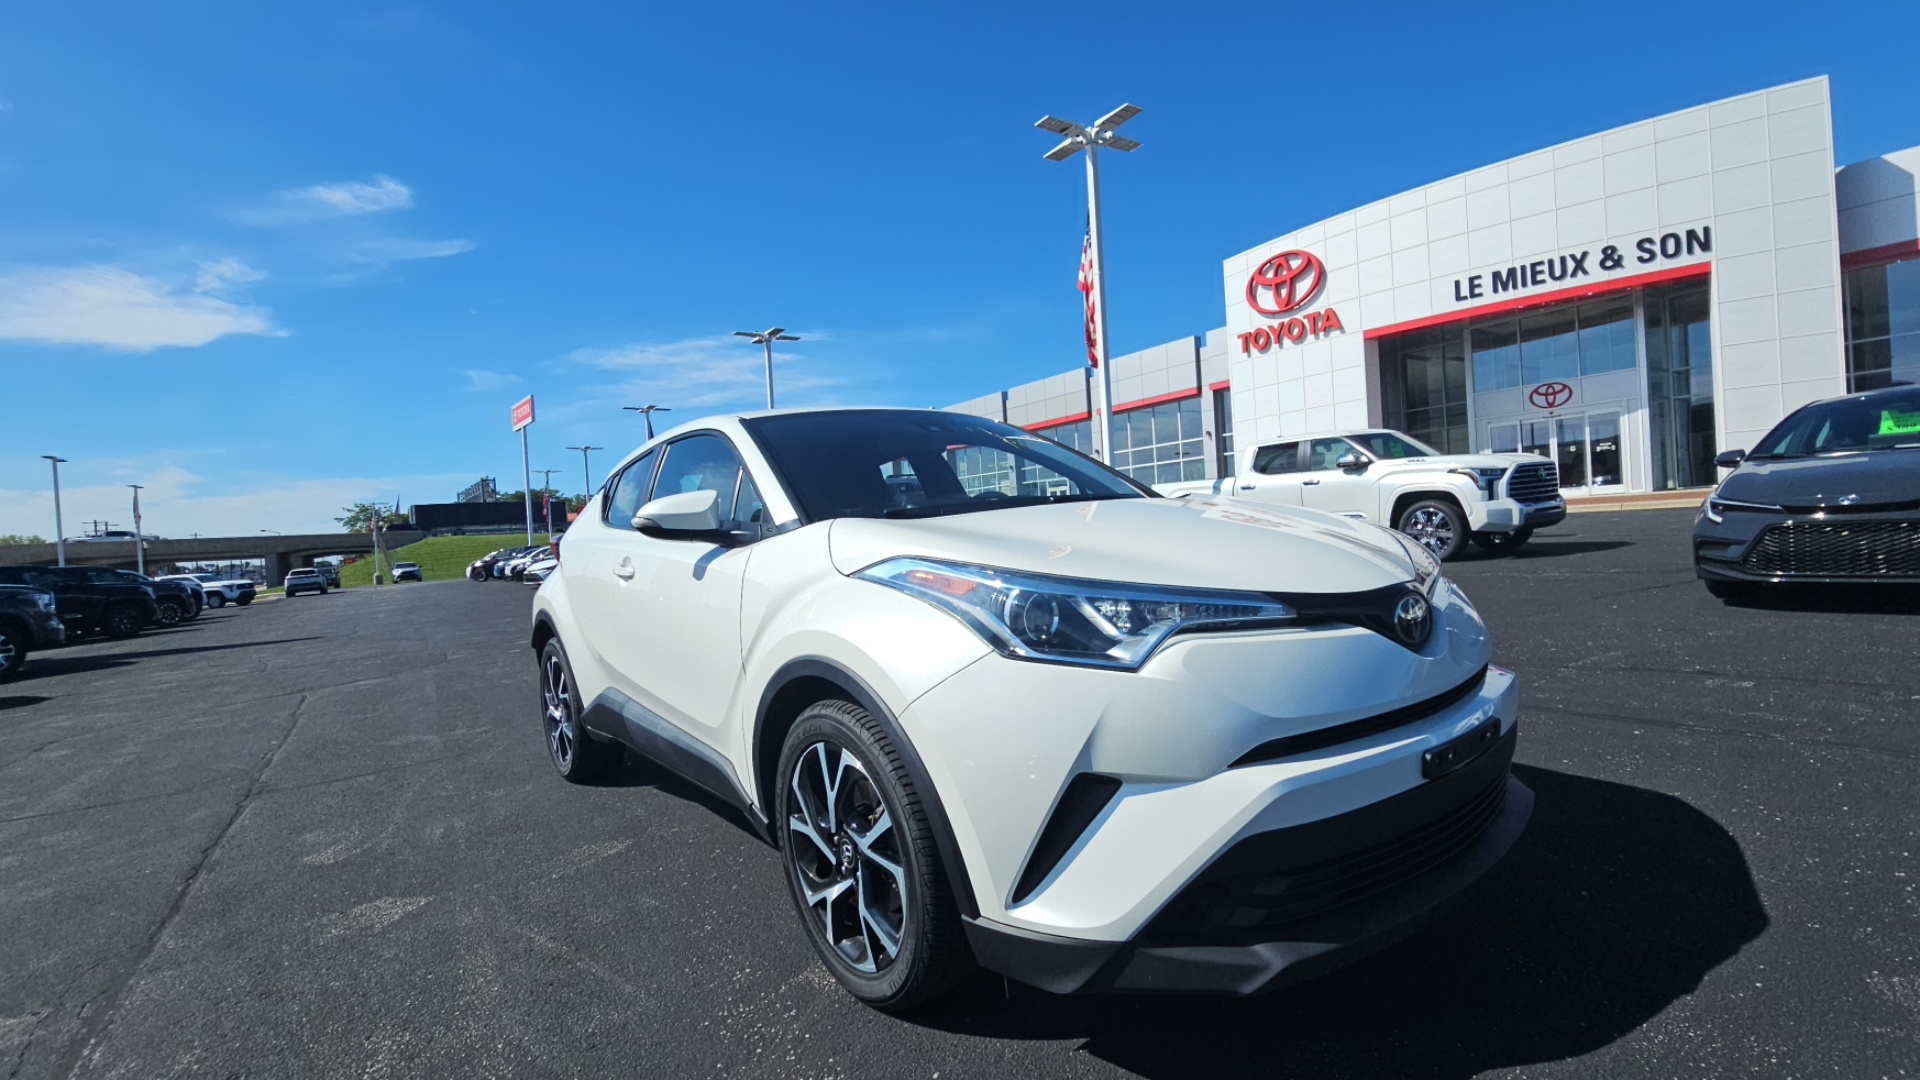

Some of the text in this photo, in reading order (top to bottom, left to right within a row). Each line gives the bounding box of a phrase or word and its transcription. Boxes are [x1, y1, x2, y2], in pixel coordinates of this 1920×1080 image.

[1454, 226, 1712, 302] LE MIEUX & SON
[1237, 308, 1343, 354] TOYOTA
